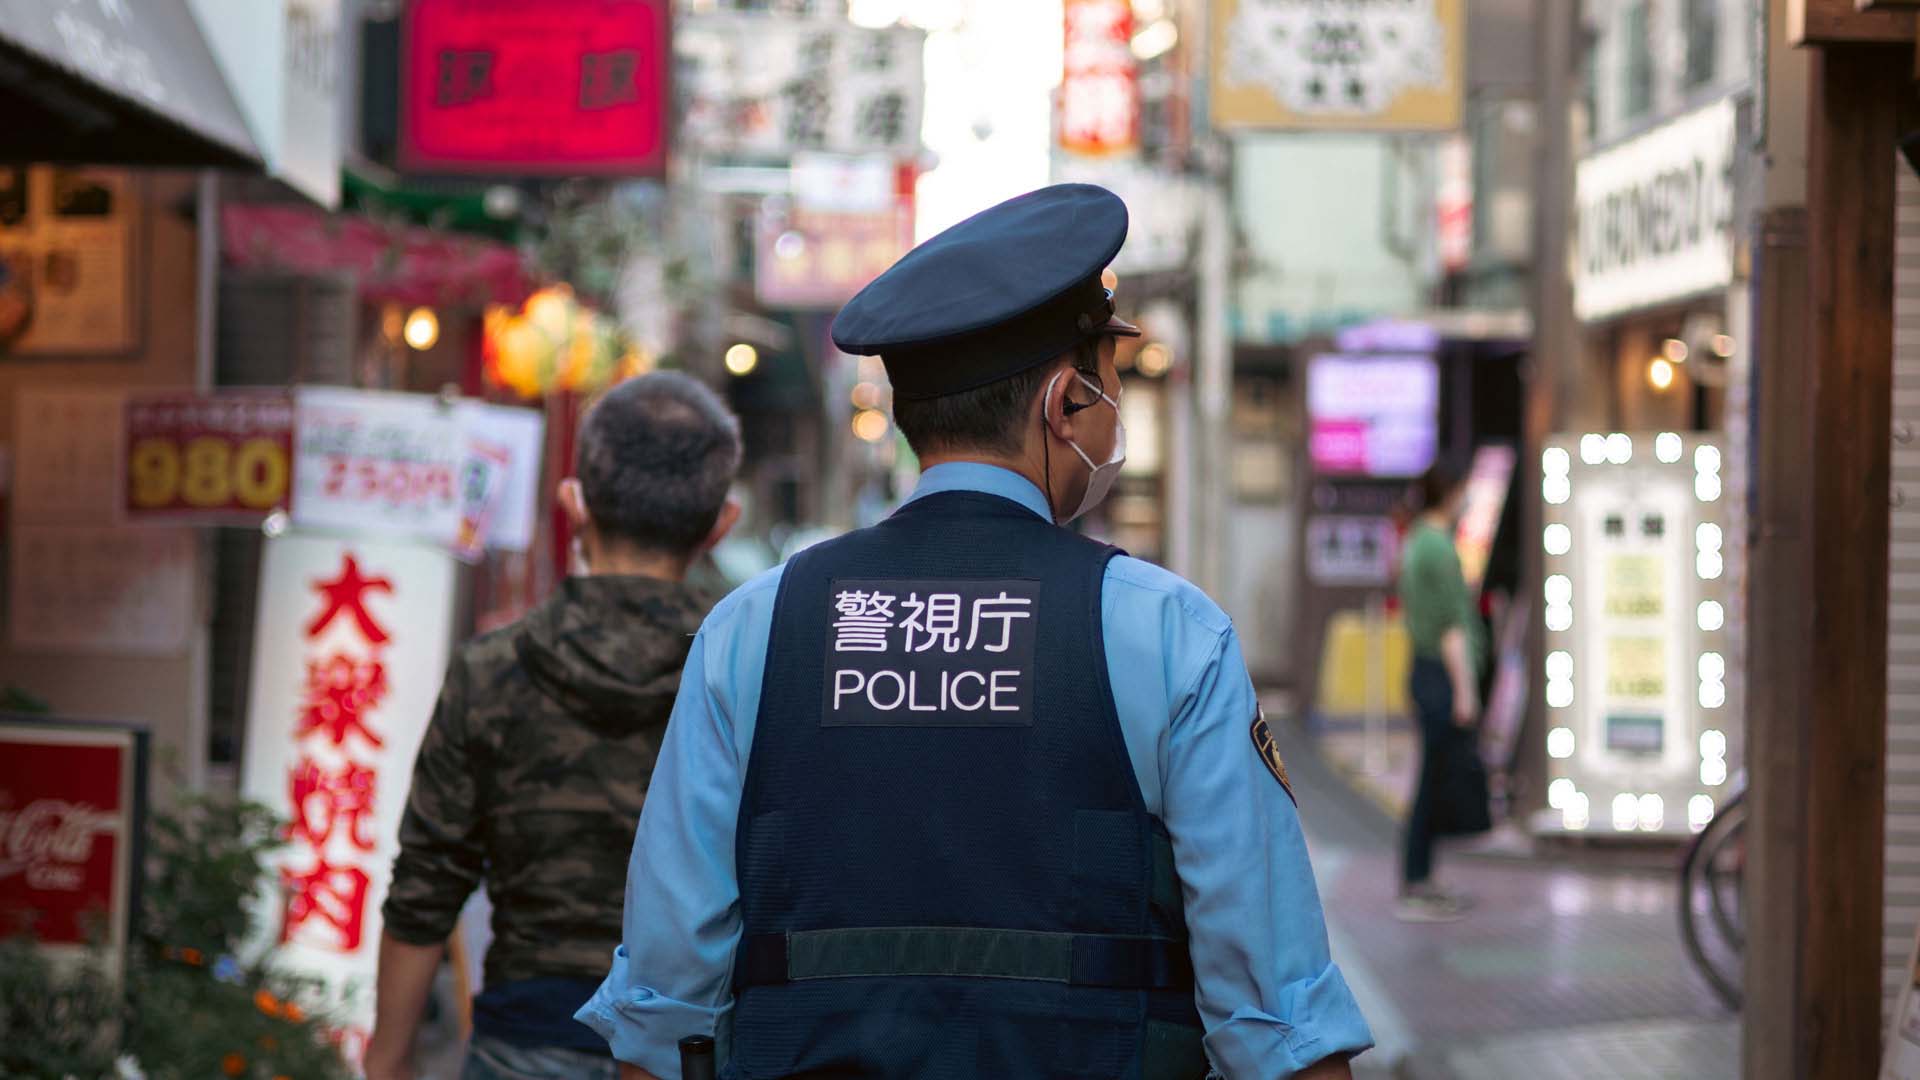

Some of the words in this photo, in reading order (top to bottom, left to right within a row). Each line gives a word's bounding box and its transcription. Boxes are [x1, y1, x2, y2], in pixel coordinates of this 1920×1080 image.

[132, 437, 284, 507] 980
[832, 589, 1032, 653] 警視庁
[833, 669, 1021, 711] POLICE
